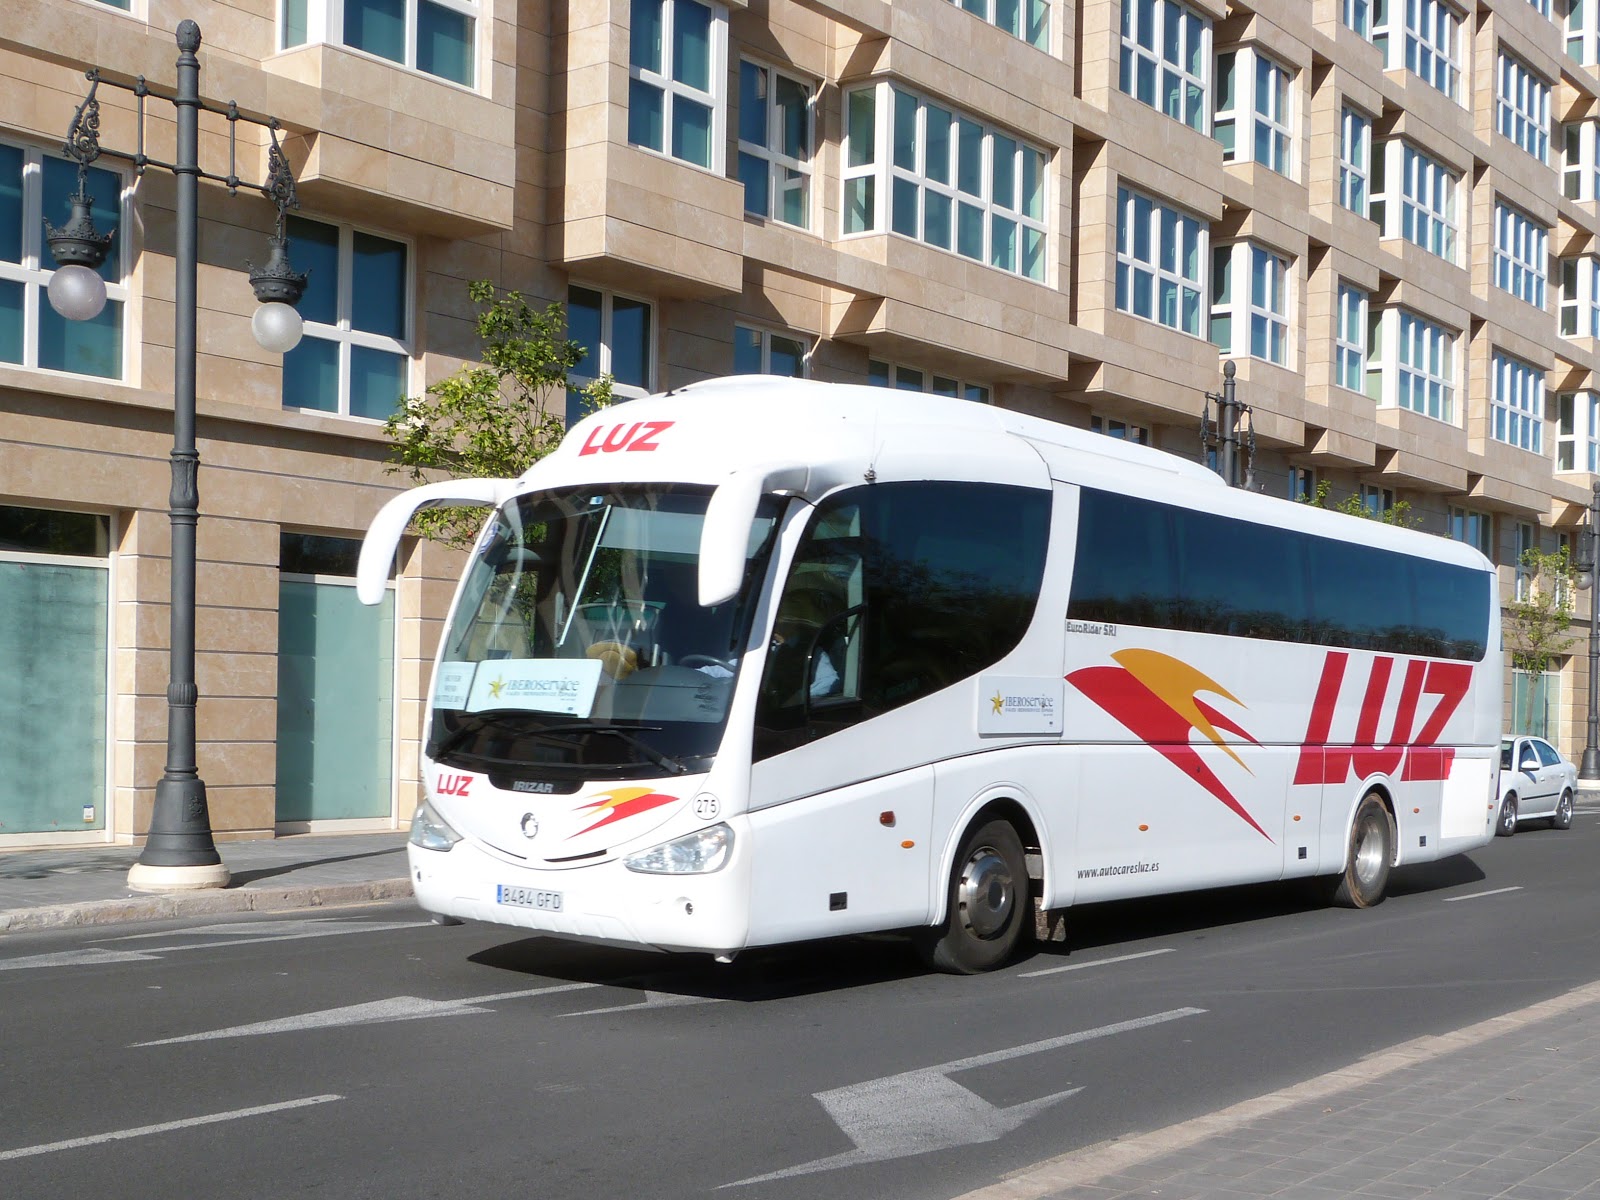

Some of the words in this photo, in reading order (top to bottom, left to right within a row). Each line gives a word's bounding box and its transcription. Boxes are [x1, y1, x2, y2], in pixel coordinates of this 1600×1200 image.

[578, 421, 676, 457] LUZ
[1292, 651, 1473, 785] LUZ
[437, 773, 474, 797] LUZ
[512, 780, 554, 794] IRIZAR
[697, 799, 717, 813] 275
[1077, 861, 1160, 879] www.autocaresluz.es
[503, 887, 533, 906] 8484
[537, 892, 561, 909] GFD
